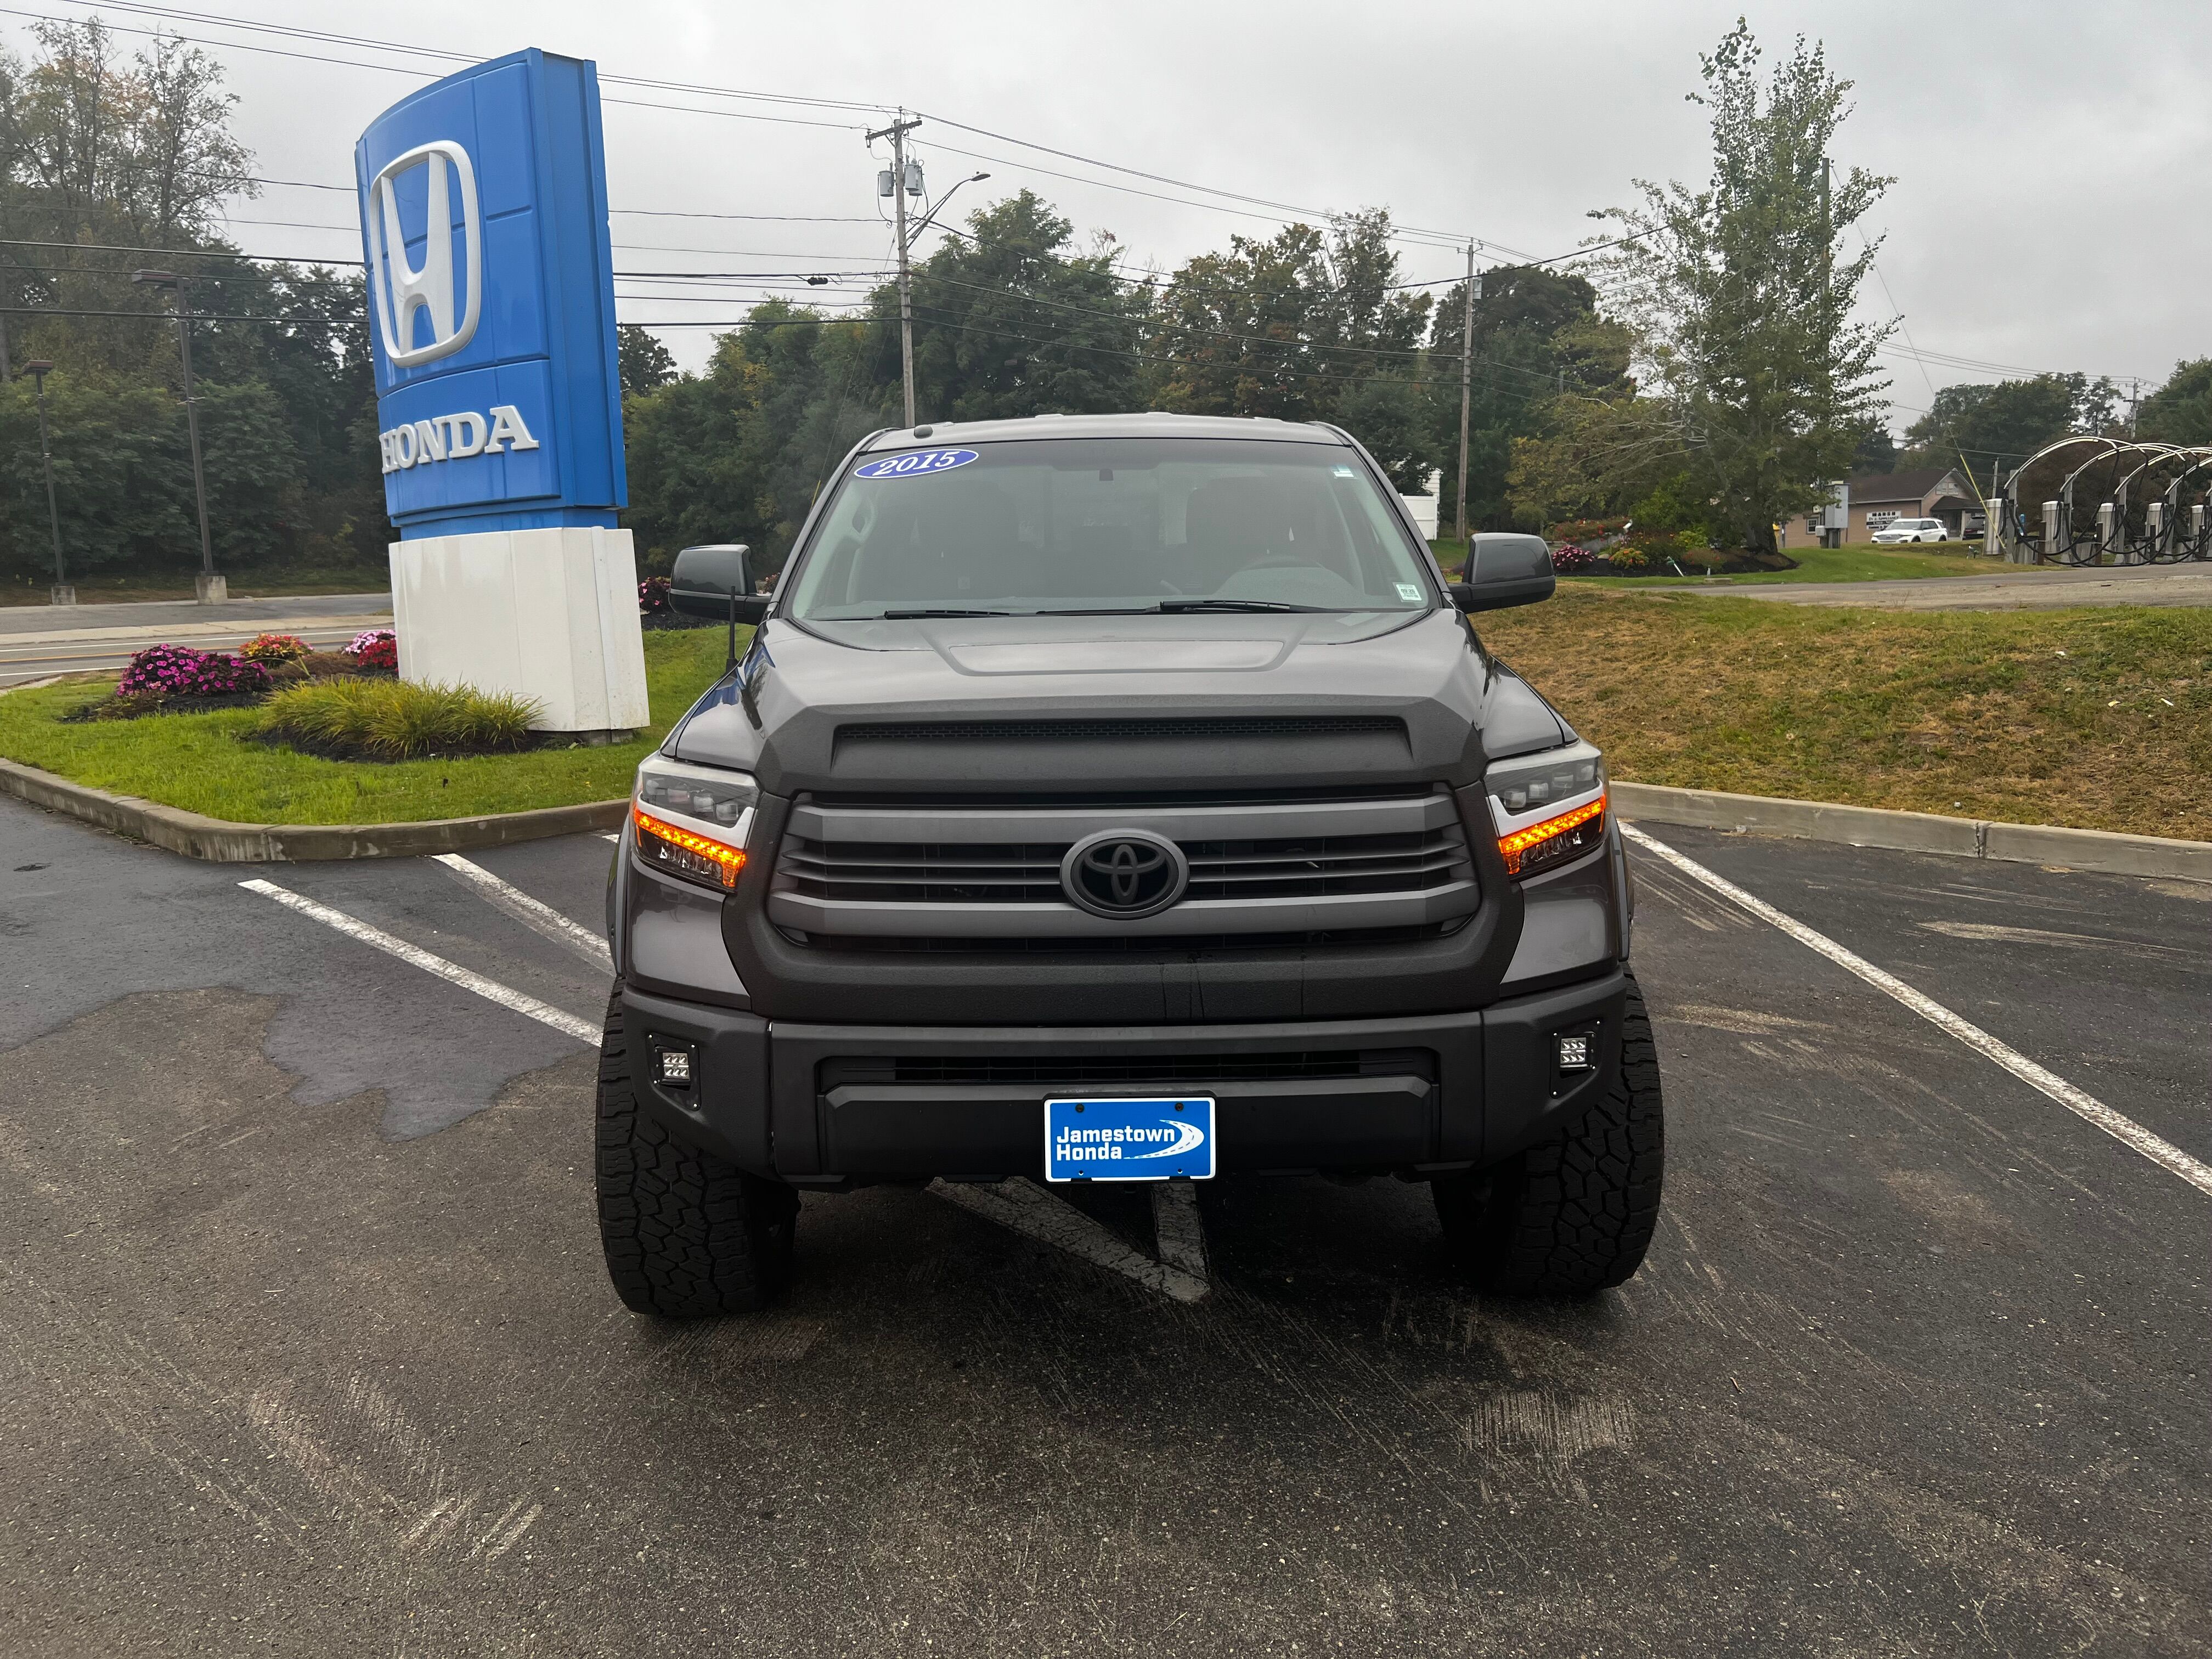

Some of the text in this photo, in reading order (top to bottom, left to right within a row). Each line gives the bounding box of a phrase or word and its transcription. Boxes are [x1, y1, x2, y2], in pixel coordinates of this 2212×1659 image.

[379, 405, 539, 474] HONDA
[872, 451, 960, 476] 2015
[1057, 1125, 1175, 1143] Jamestown
[1057, 1142, 1122, 1161] Honda
